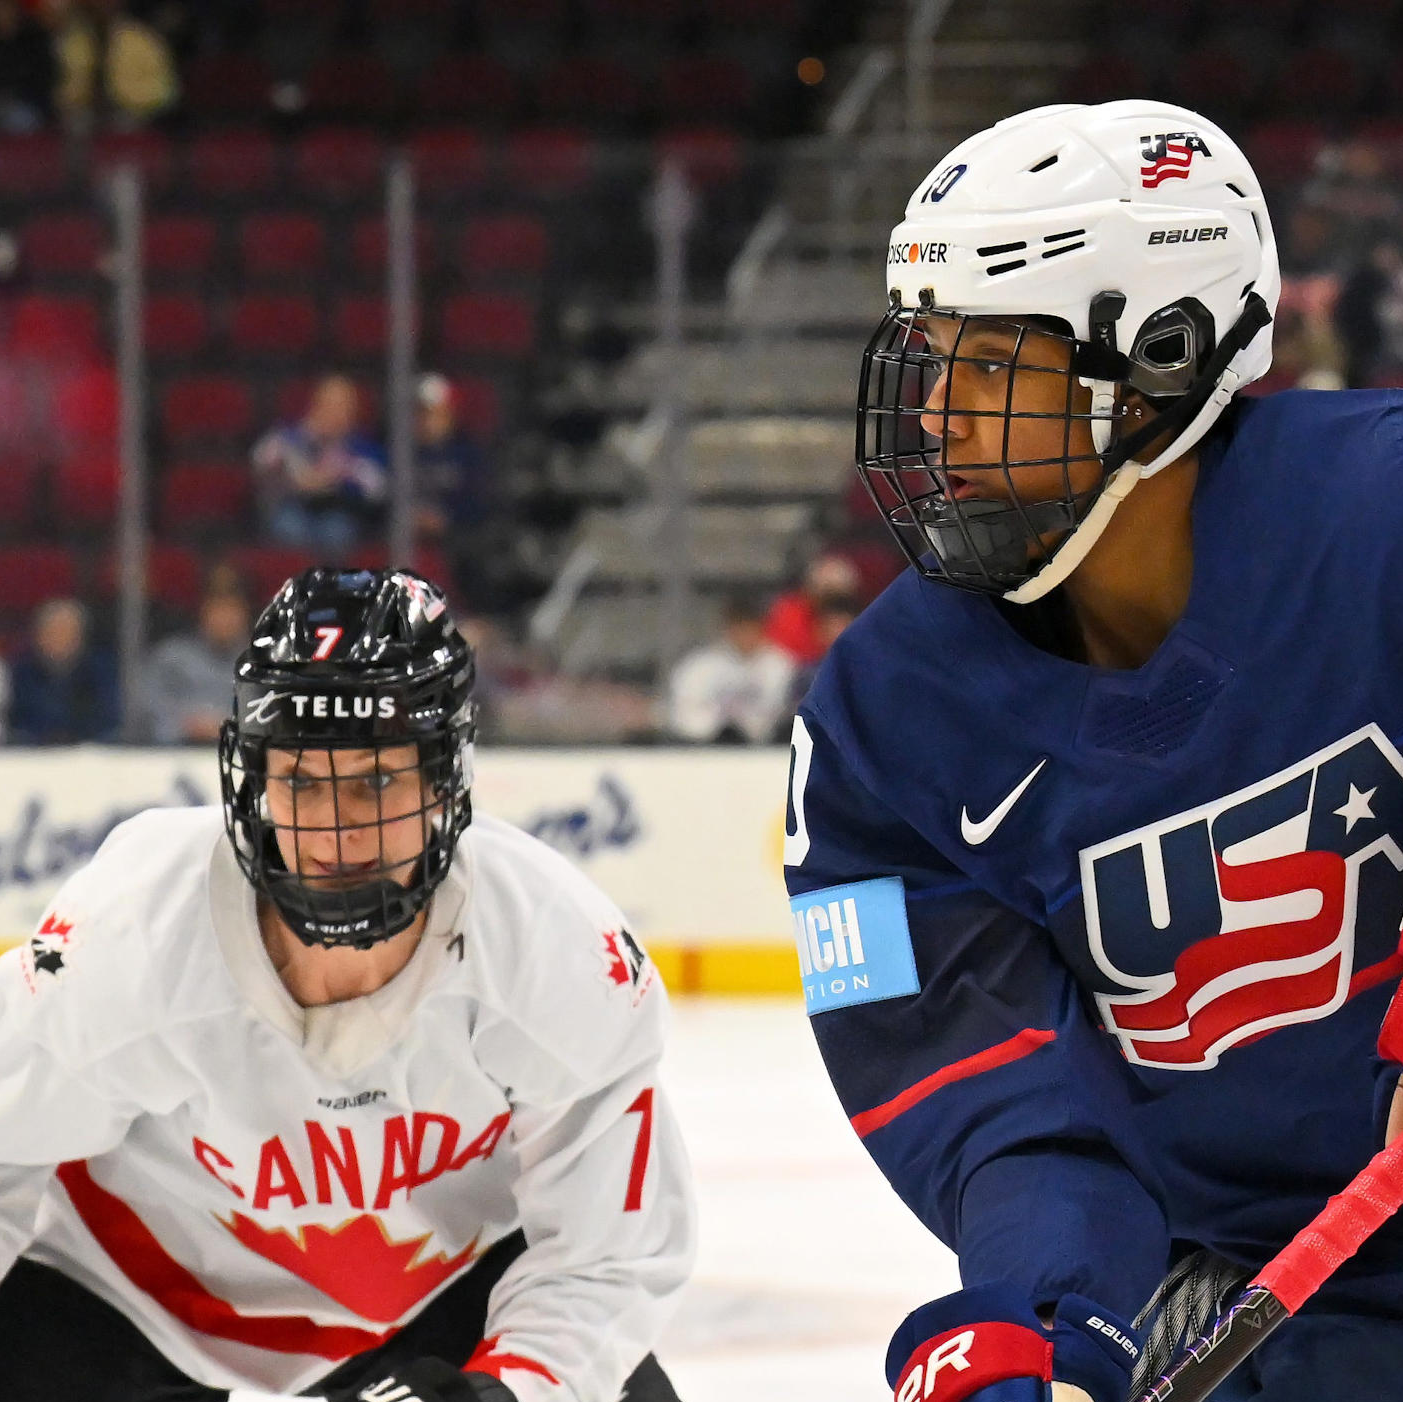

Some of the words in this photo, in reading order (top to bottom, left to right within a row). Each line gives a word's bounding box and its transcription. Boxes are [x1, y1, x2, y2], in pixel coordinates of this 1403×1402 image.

[1140, 132, 1213, 188] USA
[1148, 226, 1228, 245] BAUER
[888, 242, 948, 265] DISCOVER
[312, 626, 344, 661] 7
[291, 695, 397, 719] TELUS
[191, 1110, 512, 1212] CANADA
[1085, 1315, 1139, 1359] BAUER
